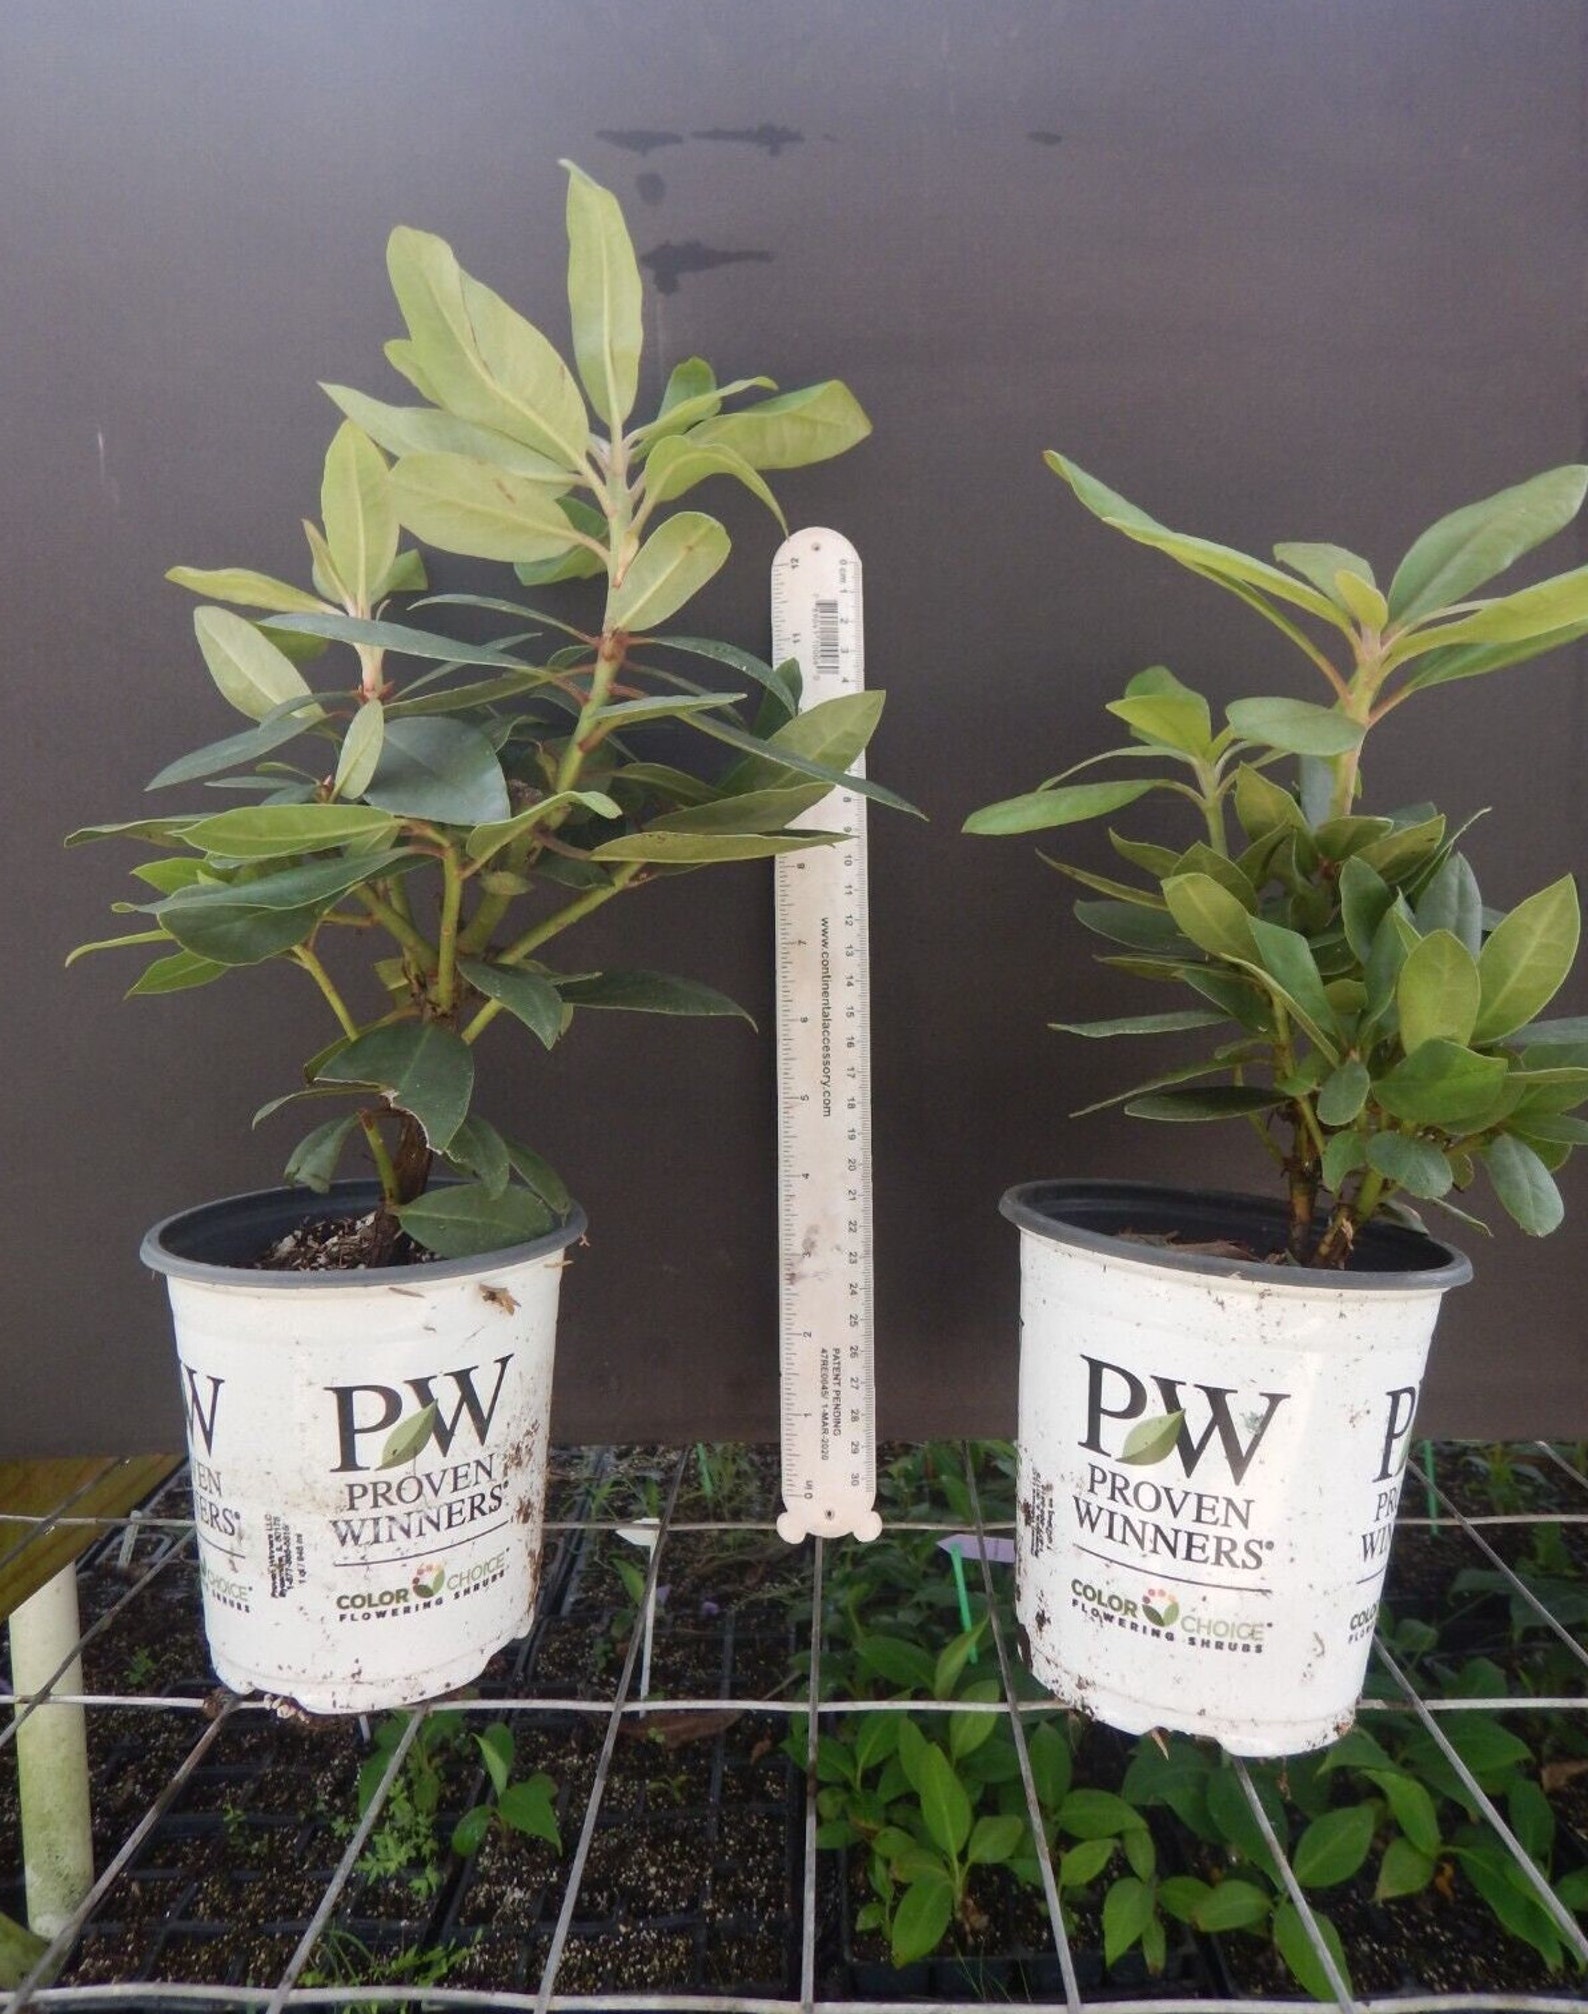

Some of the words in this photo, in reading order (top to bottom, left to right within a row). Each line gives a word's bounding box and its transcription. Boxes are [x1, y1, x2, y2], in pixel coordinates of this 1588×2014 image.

[843, 854, 853, 867] 10
[844, 884, 854, 896] 11
[844, 914, 854, 927] 12
[845, 944, 855, 958] 13
[820, 917, 832, 1118] www.continentalaccessory.com
[845, 1005, 855, 1018] 15
[845, 1036, 856, 1049] 16
[846, 1066, 857, 1079] 17
[846, 1096, 857, 1109] 18
[847, 1127, 857, 1141] 19
[847, 1158, 857, 1172] 20
[848, 1189, 858, 1202] 21
[848, 1219, 859, 1233] 22
[849, 1251, 859, 1265] 23
[849, 1282, 859, 1296] 24
[849, 1313, 860, 1327] 25
[849, 1344, 860, 1359] 26
[832, 1348, 842, 1386] PATENT
[850, 1377, 860, 1390] 27
[323, 1353, 515, 1473] PW
[832, 1390, 842, 1437] PENDING
[850, 1408, 860, 1423] 28
[1078, 1353, 1292, 1486] PW
[850, 1440, 860, 1455] 29
[345, 1452, 495, 1512] PROVEN
[850, 1472, 860, 1487] 30
[1087, 1462, 1256, 1530] PROVEN
[336, 1588, 410, 1611] COLOR
[446, 1552, 507, 1591] CHOICE
[338, 1597, 444, 1622] FLOWERING
[1071, 1578, 1139, 1619] COLOR
[1180, 1615, 1265, 1642] CHOICE
[1071, 1598, 1176, 1642] FLOWERING
[1187, 1636, 1264, 1653] SHRUBS
